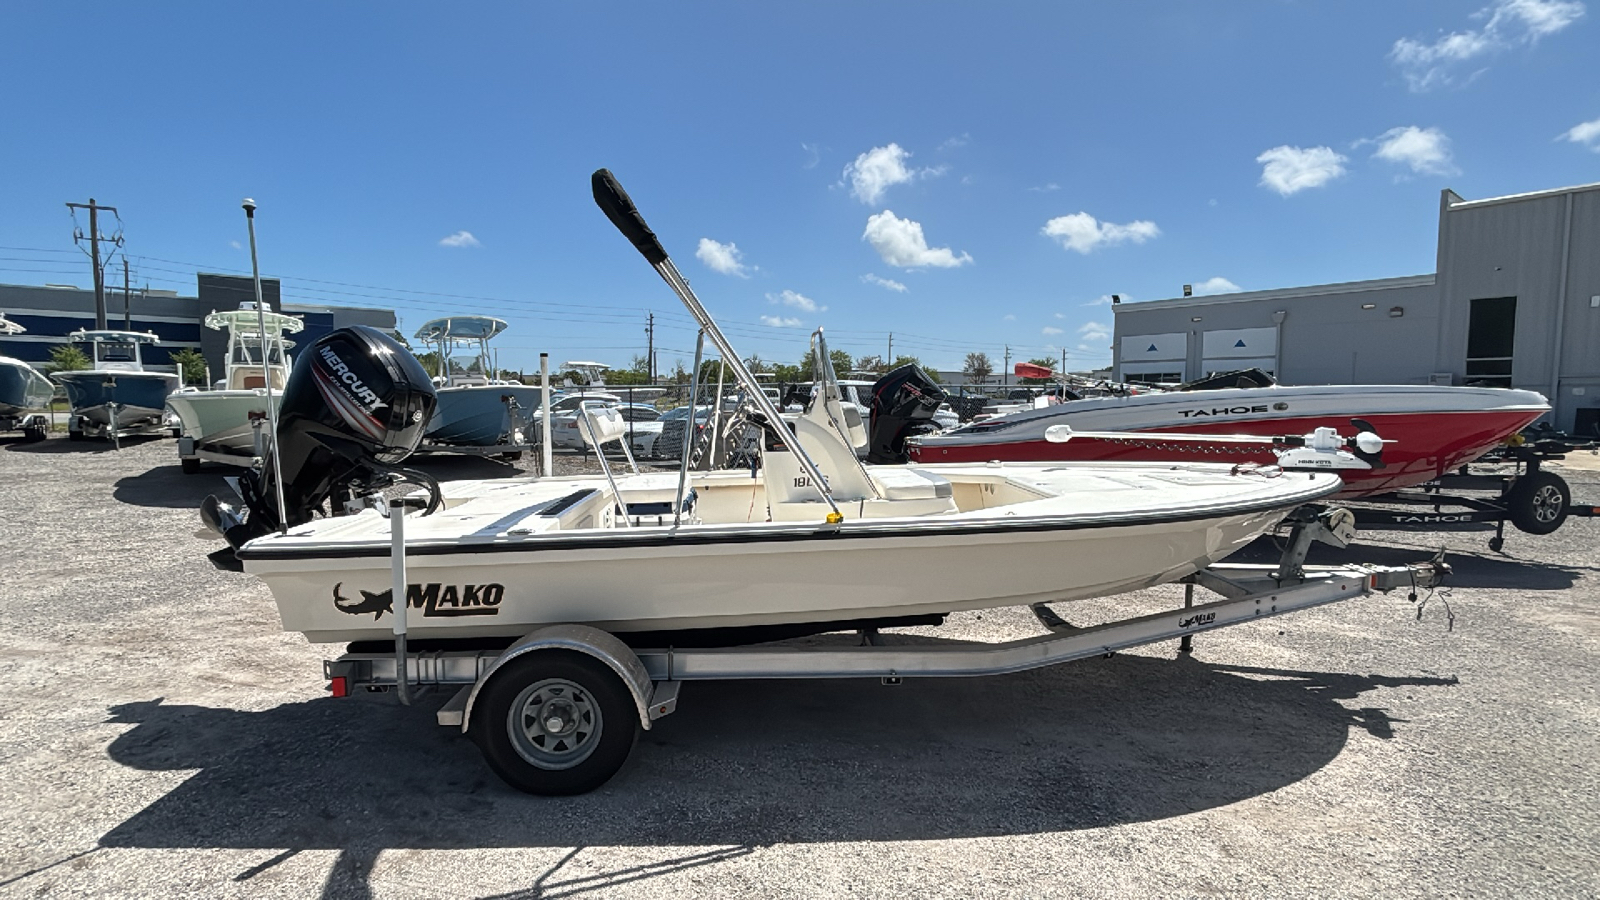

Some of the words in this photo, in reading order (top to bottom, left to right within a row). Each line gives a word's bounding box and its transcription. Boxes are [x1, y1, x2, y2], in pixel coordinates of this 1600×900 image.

[319, 345, 389, 409] MERCURY
[1178, 404, 1268, 417] TAHOE
[1391, 515, 1473, 523] TAHOE
[406, 583, 505, 617] MAKO
